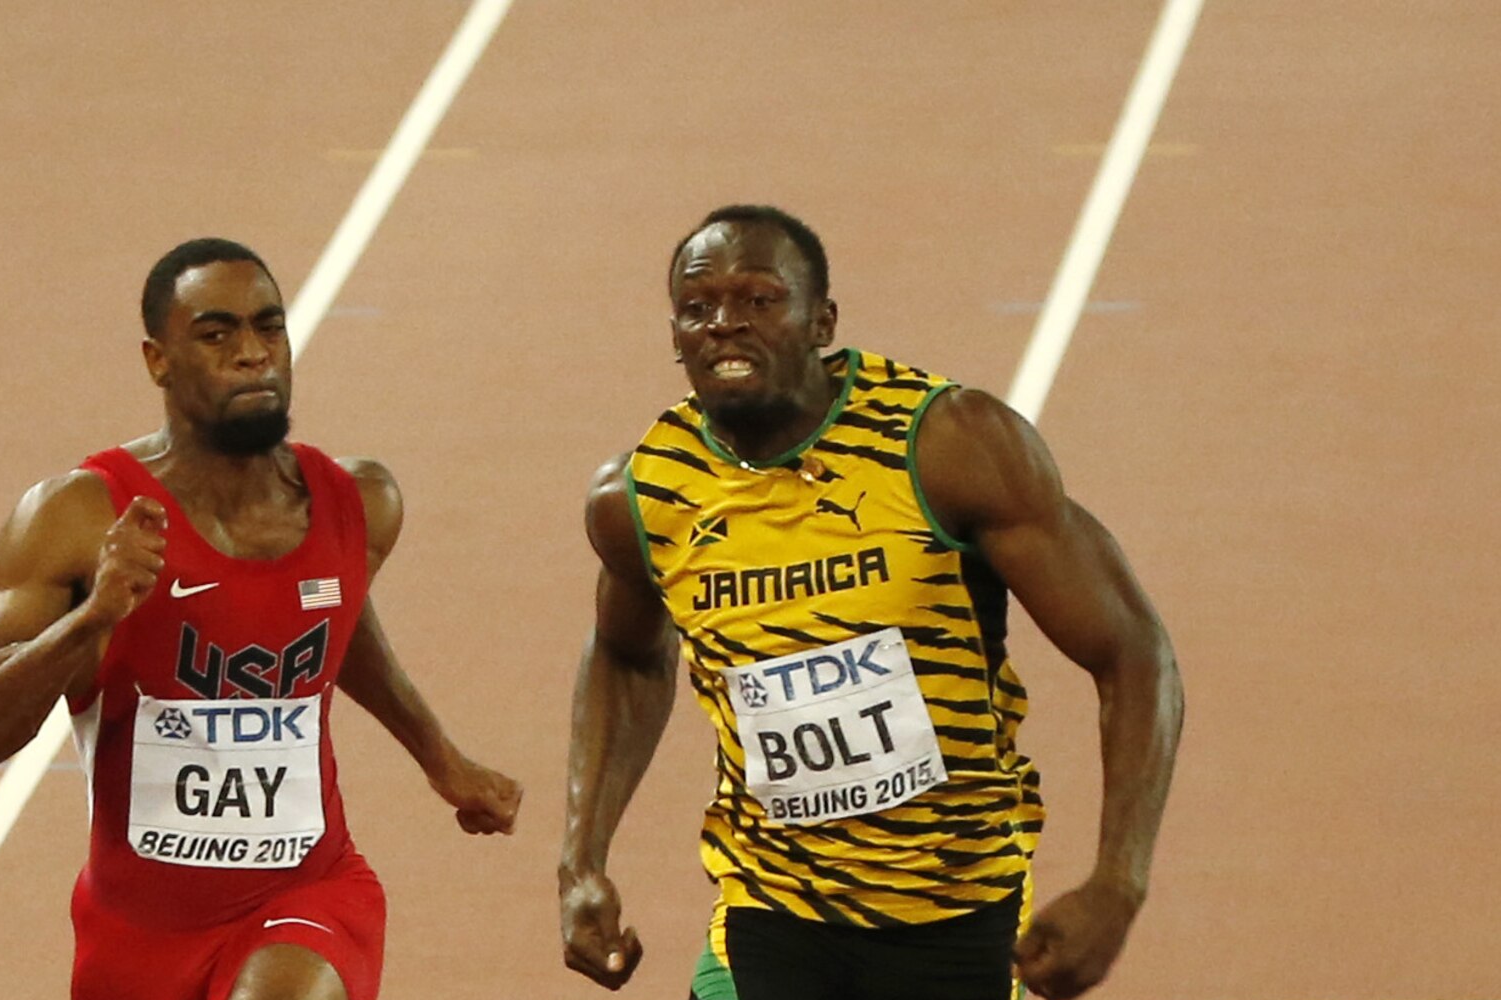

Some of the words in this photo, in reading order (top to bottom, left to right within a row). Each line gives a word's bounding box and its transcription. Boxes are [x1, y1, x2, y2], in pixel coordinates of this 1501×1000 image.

[692, 546, 890, 611] JAMAICA
[175, 618, 330, 700] USA
[763, 639, 893, 702] TDK
[192, 705, 309, 744] TDK
[757, 700, 894, 782] BOLT
[174, 764, 288, 819] GAY
[770, 785, 868, 820] BEIJING
[875, 759, 933, 804] 2015
[137, 830, 250, 862] BEIJING
[254, 836, 314, 863] 2015
